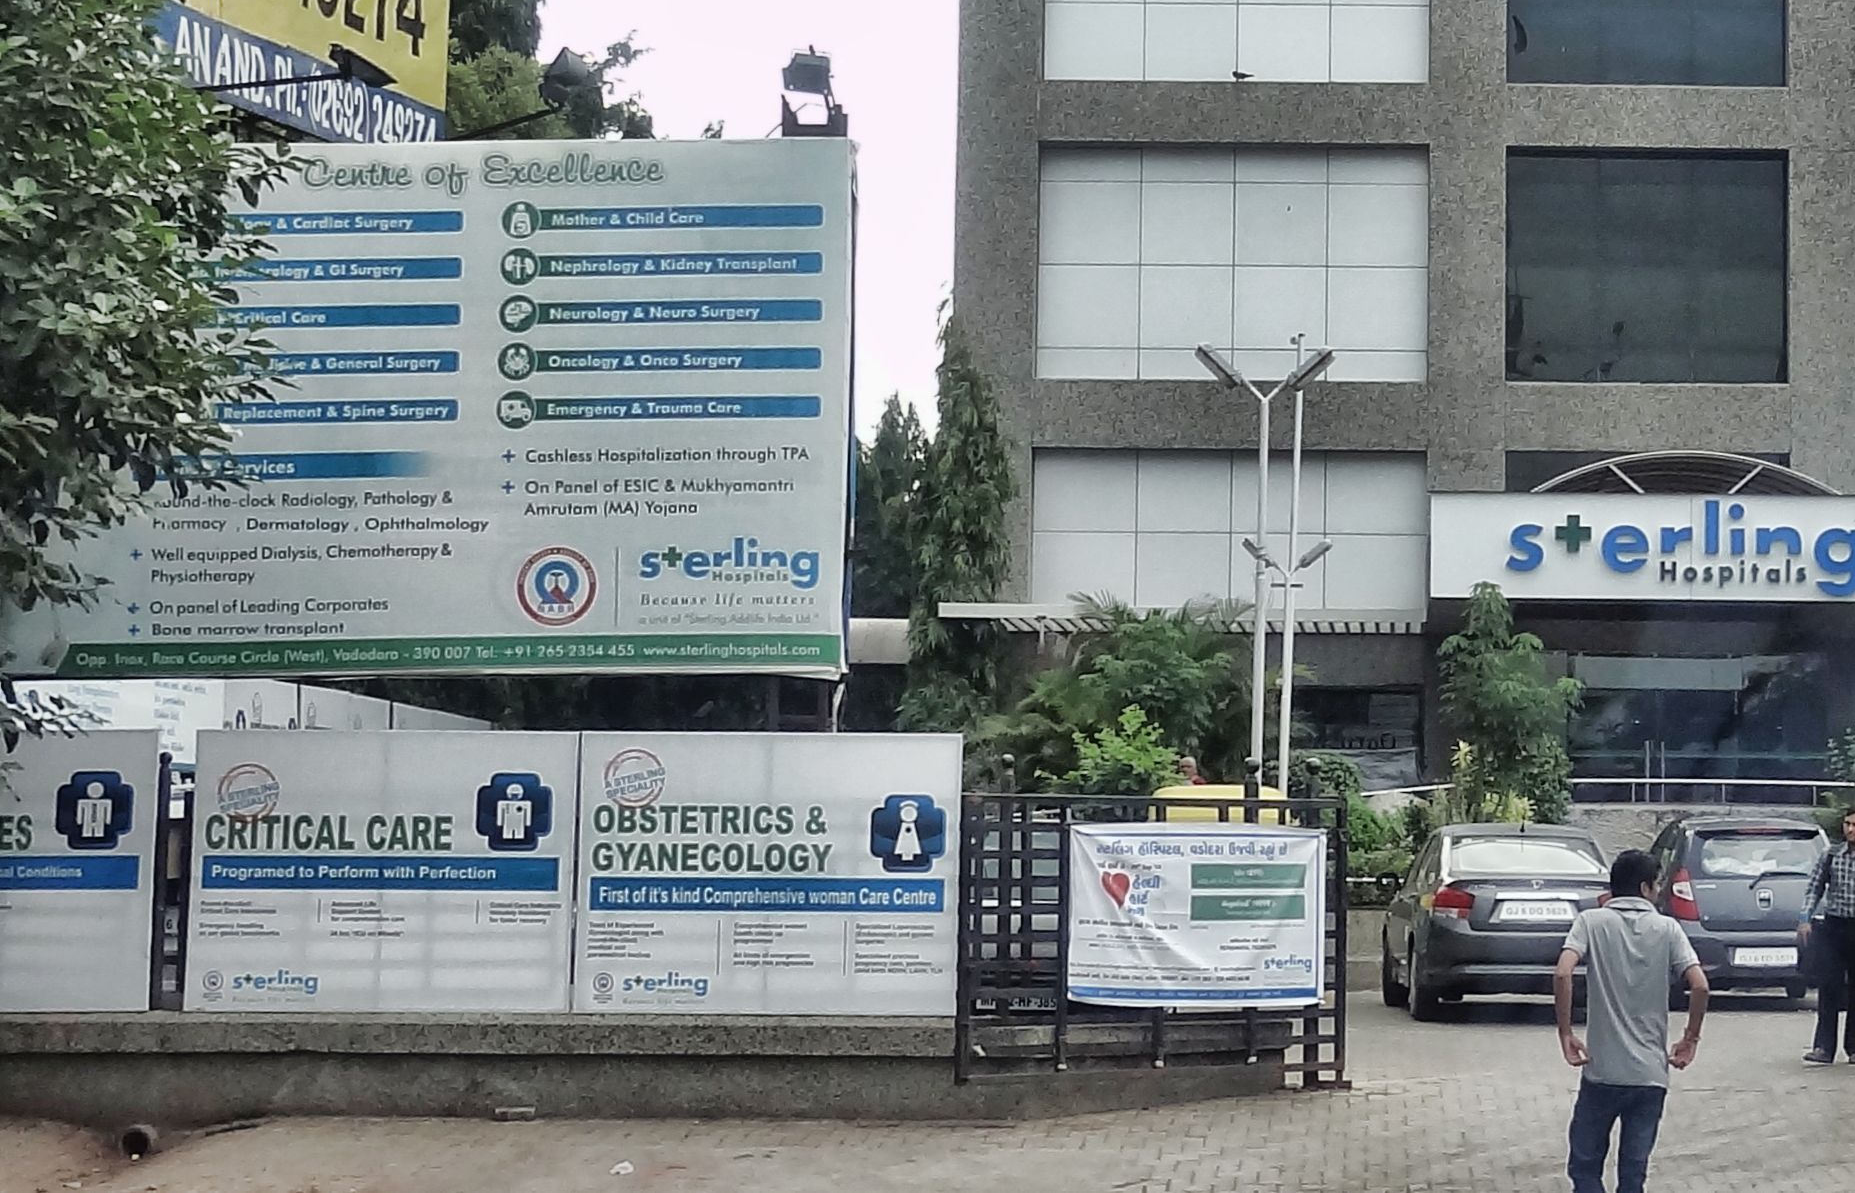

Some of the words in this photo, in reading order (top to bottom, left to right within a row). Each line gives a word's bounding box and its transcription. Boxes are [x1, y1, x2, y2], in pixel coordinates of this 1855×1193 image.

[303, 158, 413, 187] Centre
[424, 162, 468, 196] of
[482, 153, 665, 185] Excellence
[293, 218, 350, 229] Cardiac
[355, 217, 413, 231] Surgery
[551, 213, 604, 226] Mother
[626, 212, 664, 225] Child
[669, 211, 704, 224] Care
[350, 264, 404, 277] Surgery
[551, 260, 639, 274] Nephrology
[660, 259, 712, 274] Kidney
[717, 257, 797, 271] Transplant
[291, 312, 326, 324] Care
[549, 307, 628, 322] Neurology
[650, 306, 697, 319] Neuro
[701, 305, 760, 321] Surgery
[326, 357, 383, 369] General
[387, 357, 440, 371] Surgery
[548, 355, 619, 370] Oncology
[640, 354, 678, 367] Onco
[683, 353, 742, 369] Surgery
[223, 406, 322, 421] Replacement
[343, 405, 385, 421] Spine
[390, 405, 449, 420] Surgery
[547, 403, 627, 418] Emergency
[647, 402, 702, 414] Trauma
[707, 402, 742, 414] Care
[525, 449, 592, 463] Cashless
[599, 448, 714, 465] Hospitalization
[717, 446, 776, 463] through
[782, 447, 809, 460] TPA
[525, 480, 550, 494] On
[555, 480, 597, 493] Panel
[602, 480, 620, 493] of
[624, 480, 659, 493] ESIC
[681, 478, 794, 497] Mukhyamantri
[281, 493, 358, 508] Radiology,
[363, 492, 438, 507] Pathology
[524, 503, 598, 516] Amrutam
[603, 501, 639, 517] (MA)
[644, 501, 698, 518] Yojana
[246, 519, 349, 534] Dermatology
[365, 518, 490, 533] Ophthalmology
[151, 549, 184, 562] Well
[187, 549, 258, 564] equipped
[261, 546, 322, 562] Dialysis,
[326, 544, 438, 560] Chemotherapy
[640, 536, 820, 590] sterling
[151, 570, 255, 586] Physiotherapy
[711, 571, 790, 585] Hospitals
[1659, 559, 1807, 589] Hospitals
[150, 601, 173, 614] On
[176, 601, 219, 616] panel
[222, 600, 239, 613] of
[240, 599, 300, 615] Leading
[304, 598, 389, 614] Corporates
[640, 594, 707, 606] Because
[714, 594, 743, 606] life
[752, 595, 815, 606] matters
[151, 624, 192, 636] Bone
[197, 625, 260, 636] marrow
[263, 622, 344, 637] transplant
[188, 651, 237, 665] Course
[240, 649, 280, 665] Circle
[333, 648, 399, 662] Vadodara
[413, 647, 440, 660] 390
[443, 646, 472, 660] 007
[608, 644, 635, 656] 455
[643, 642, 820, 659] www.sterlinghospitals.com
[593, 805, 794, 835] OBSTETRICS
[804, 805, 828, 835] &
[205, 814, 355, 850] CRITICAL
[371, 815, 453, 851] CARE
[592, 843, 832, 872] GYANECOLOGY
[17, 866, 82, 877] Conditions
[212, 865, 294, 880] Programed
[299, 866, 314, 878] to
[319, 865, 379, 878] Perform
[379, 865, 416, 880] with
[420, 865, 496, 880] Perfection
[599, 887, 630, 903] First
[633, 888, 647, 903] of
[672, 887, 700, 903] kind
[704, 887, 805, 907] Comprehensive
[809, 890, 856, 904] woman
[859, 888, 890, 904] Care
[893, 889, 936, 905] Centre
[1264, 955, 1312, 972] sterling
